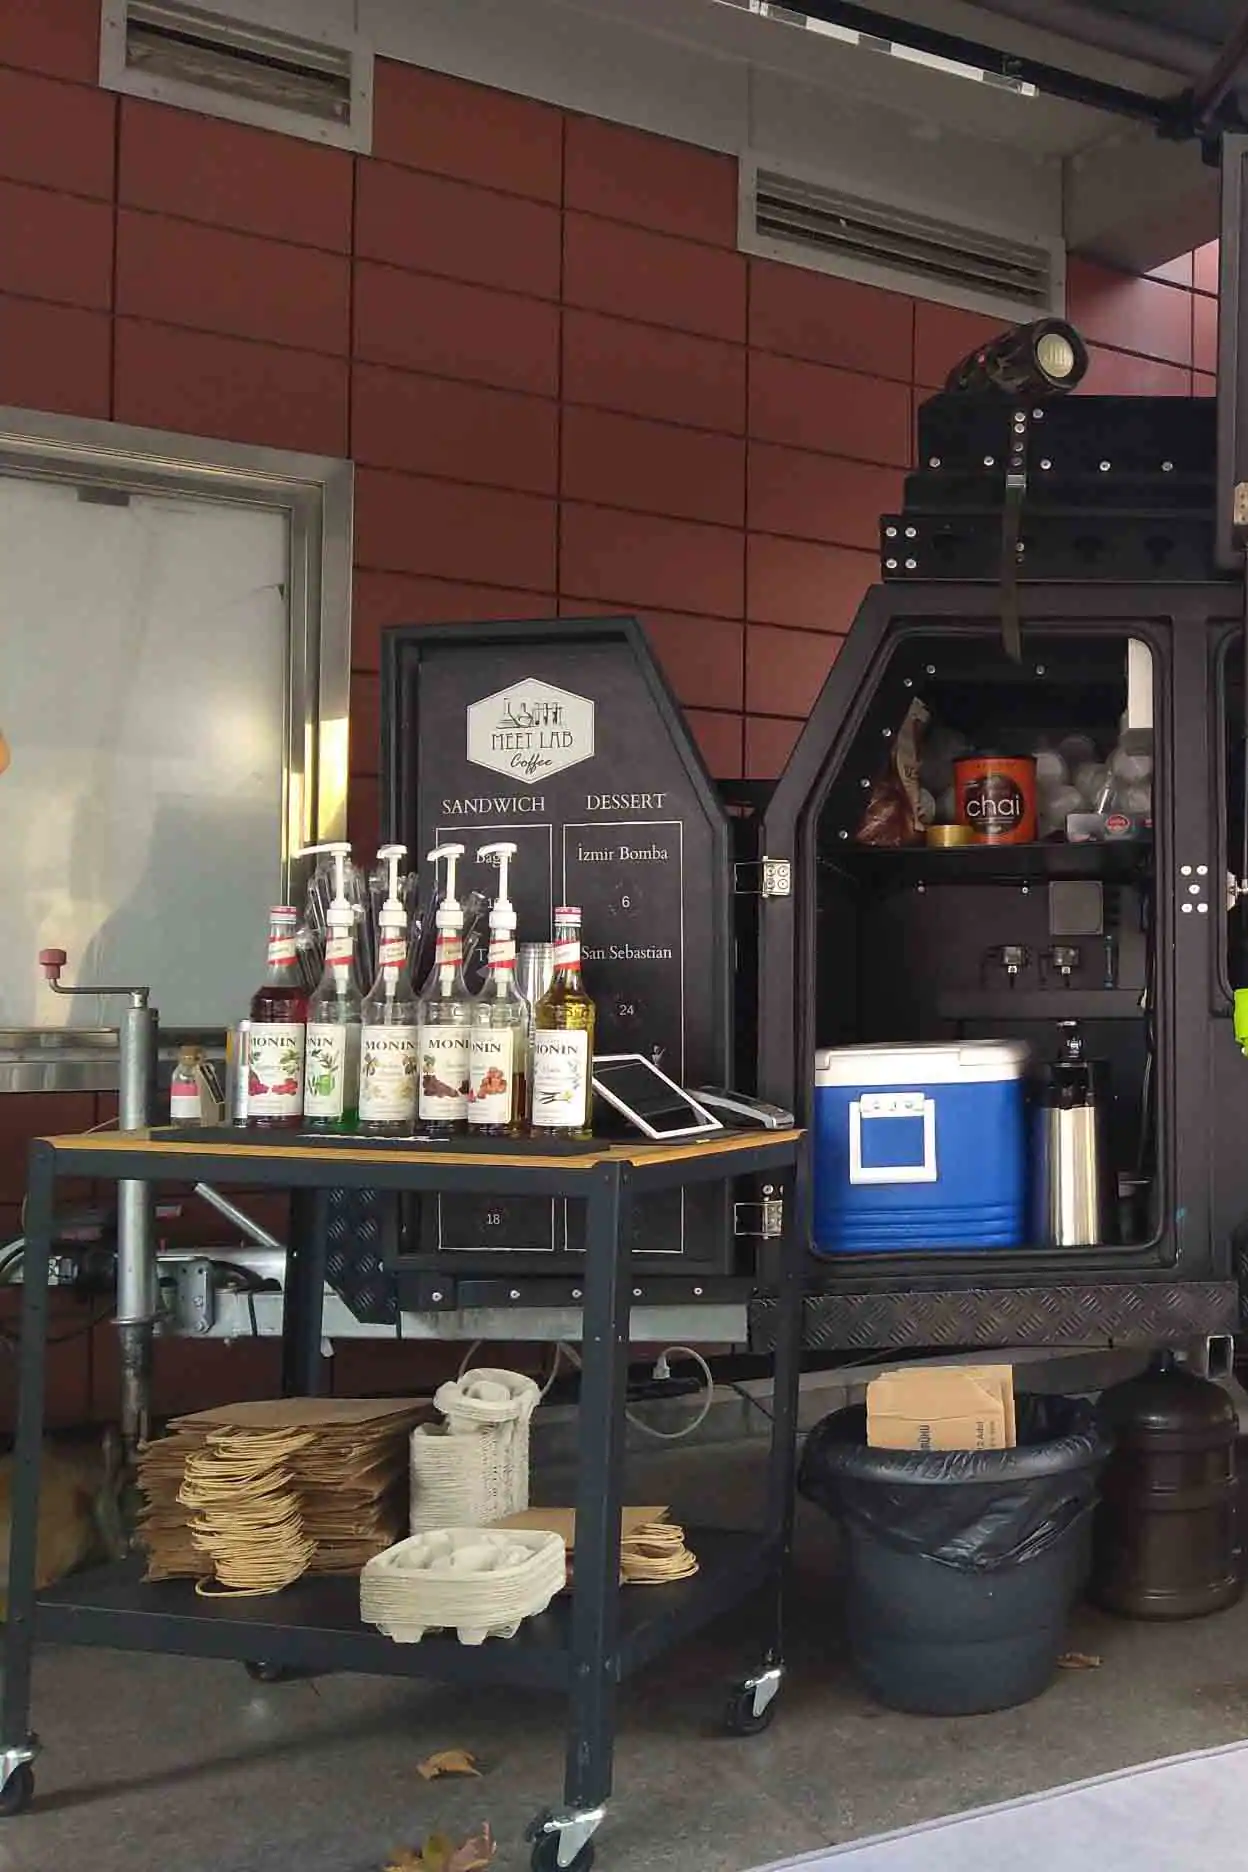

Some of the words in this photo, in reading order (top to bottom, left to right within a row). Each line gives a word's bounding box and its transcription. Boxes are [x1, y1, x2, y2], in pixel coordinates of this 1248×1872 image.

[491, 732, 533, 750] MEET
[540, 731, 573, 749] LAB
[510, 753, 553, 775] Coffee
[442, 796, 545, 814] SANDWICH
[586, 793, 666, 810] DESSERT
[966, 795, 1021, 817] chai
[620, 844, 668, 860] Bomba
[621, 895, 631, 908] 6
[581, 945, 605, 960] San
[609, 943, 672, 960] Sebastian
[619, 1004, 634, 1016] 24
[365, 1038, 416, 1050] MONIN
[428, 1039, 470, 1049] MONI
[487, 1213, 501, 1225] 18
